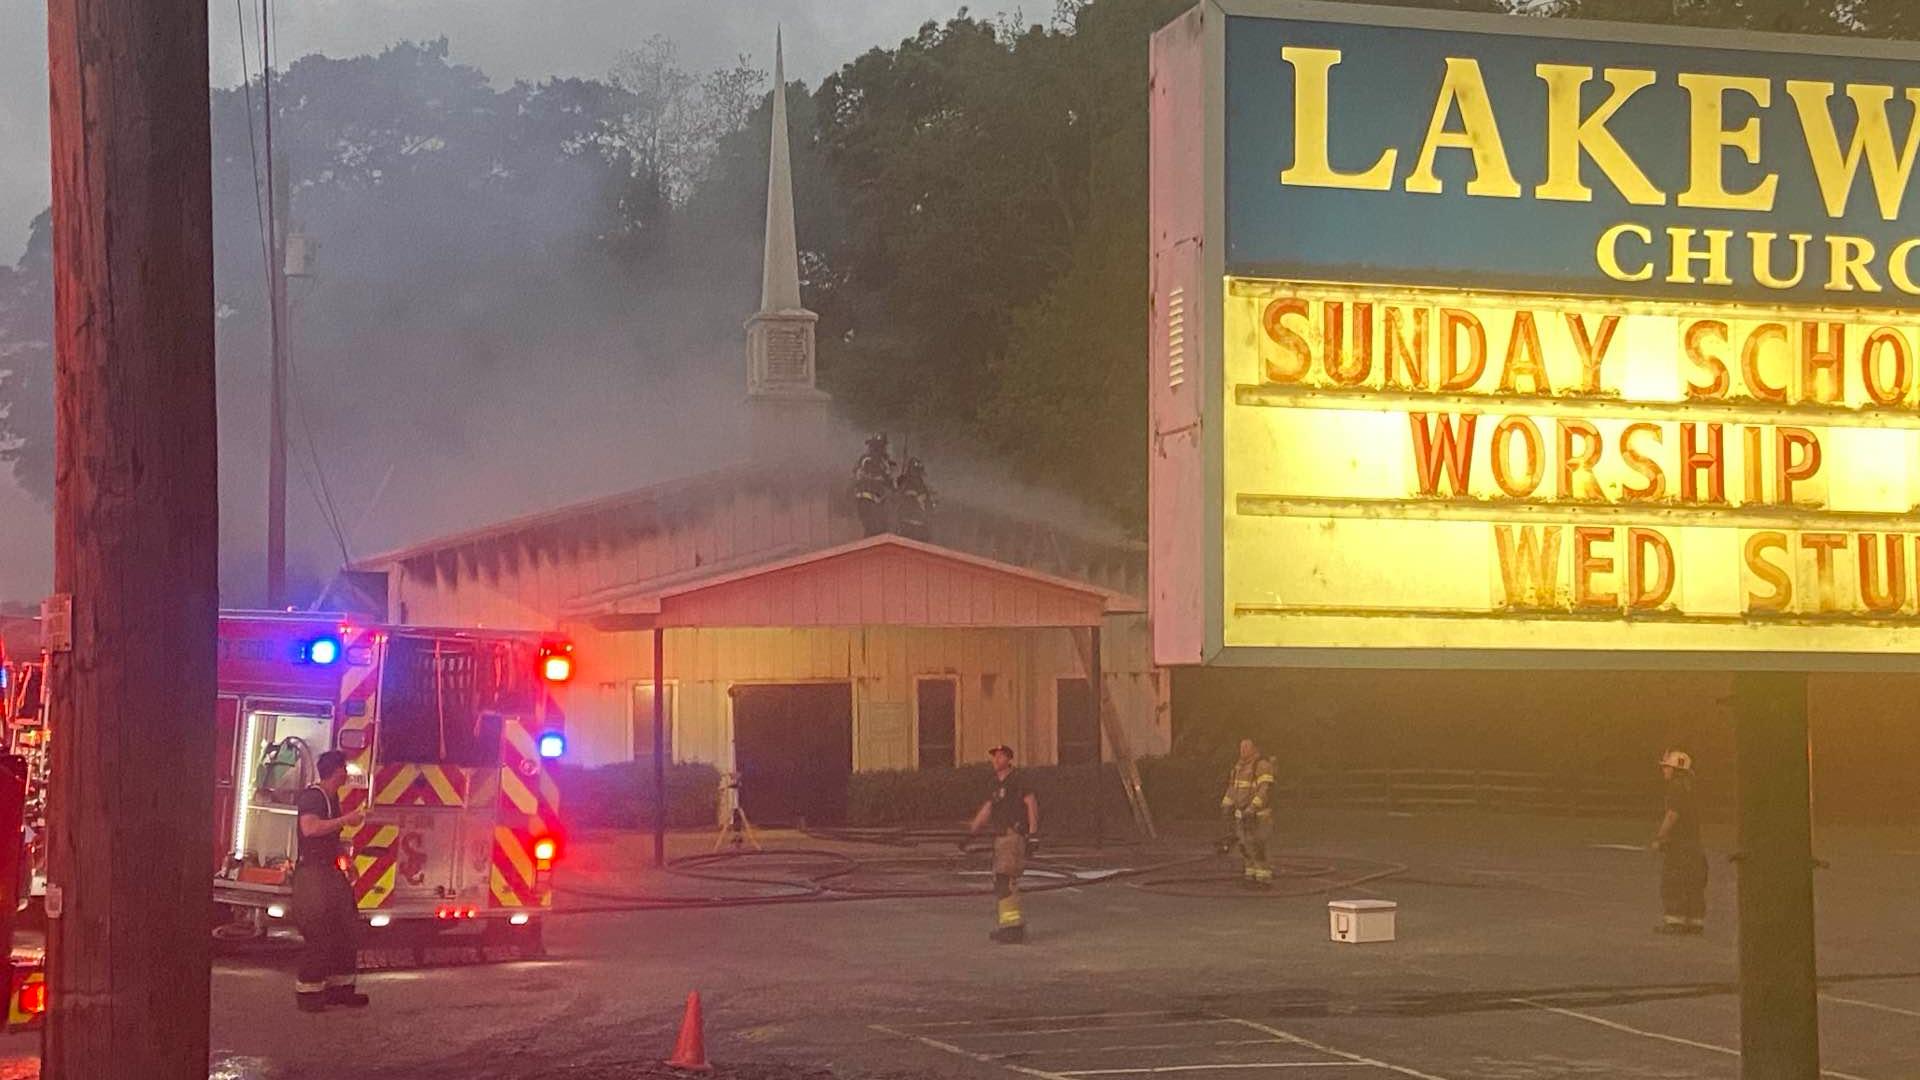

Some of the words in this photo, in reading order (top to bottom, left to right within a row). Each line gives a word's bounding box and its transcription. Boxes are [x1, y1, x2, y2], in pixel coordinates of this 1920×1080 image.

[1281, 46, 1920, 220] LAKEW
[1262, 298, 1621, 396] SUNDAY
[1685, 319, 1914, 406] SCHO
[1409, 412, 1822, 506] WORSHIP
[1495, 525, 1676, 612] WED
[1744, 531, 1920, 613] STU
